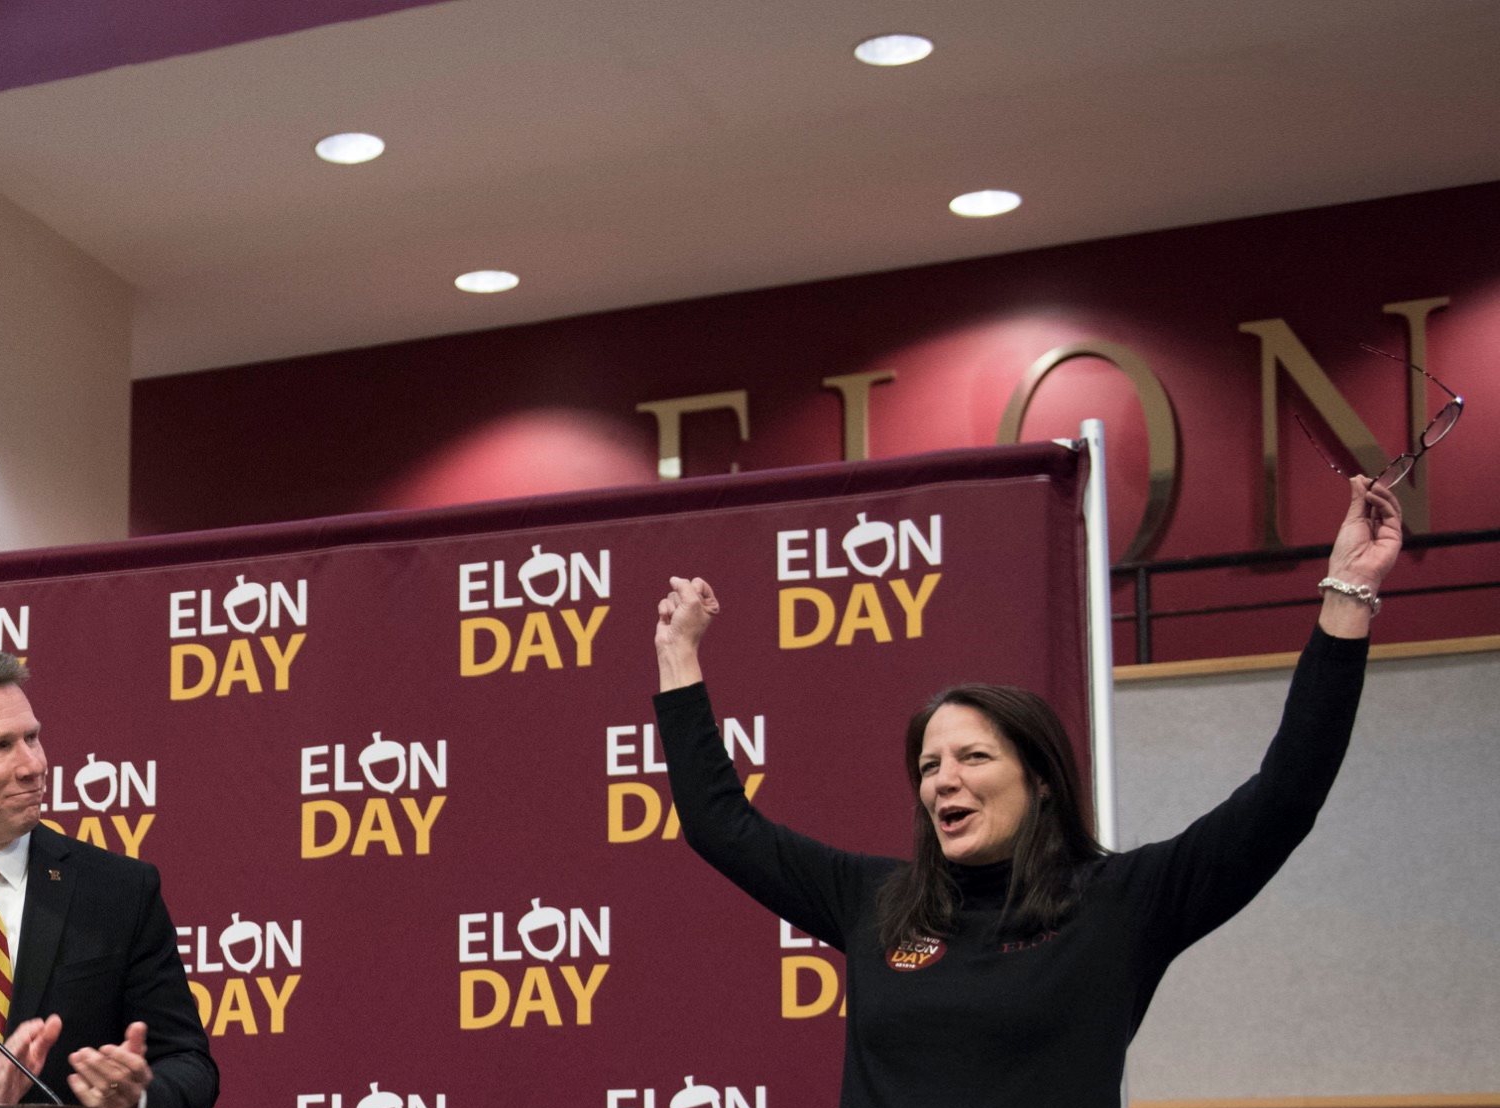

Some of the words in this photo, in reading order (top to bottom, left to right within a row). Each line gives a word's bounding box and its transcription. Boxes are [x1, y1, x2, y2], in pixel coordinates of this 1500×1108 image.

[460, 544, 610, 612] ELON
[778, 512, 942, 581] ELON
[170, 574, 308, 639] ELON
[779, 572, 942, 650] DAY
[170, 632, 307, 701] DAY
[461, 605, 610, 677] DAY
[301, 731, 447, 795] ELON
[607, 715, 765, 776] ELN
[40, 753, 156, 812] LON
[301, 795, 447, 859] DAY
[459, 897, 610, 963] ELON
[891, 950, 932, 965] DAY
[460, 963, 610, 1030] DAY
